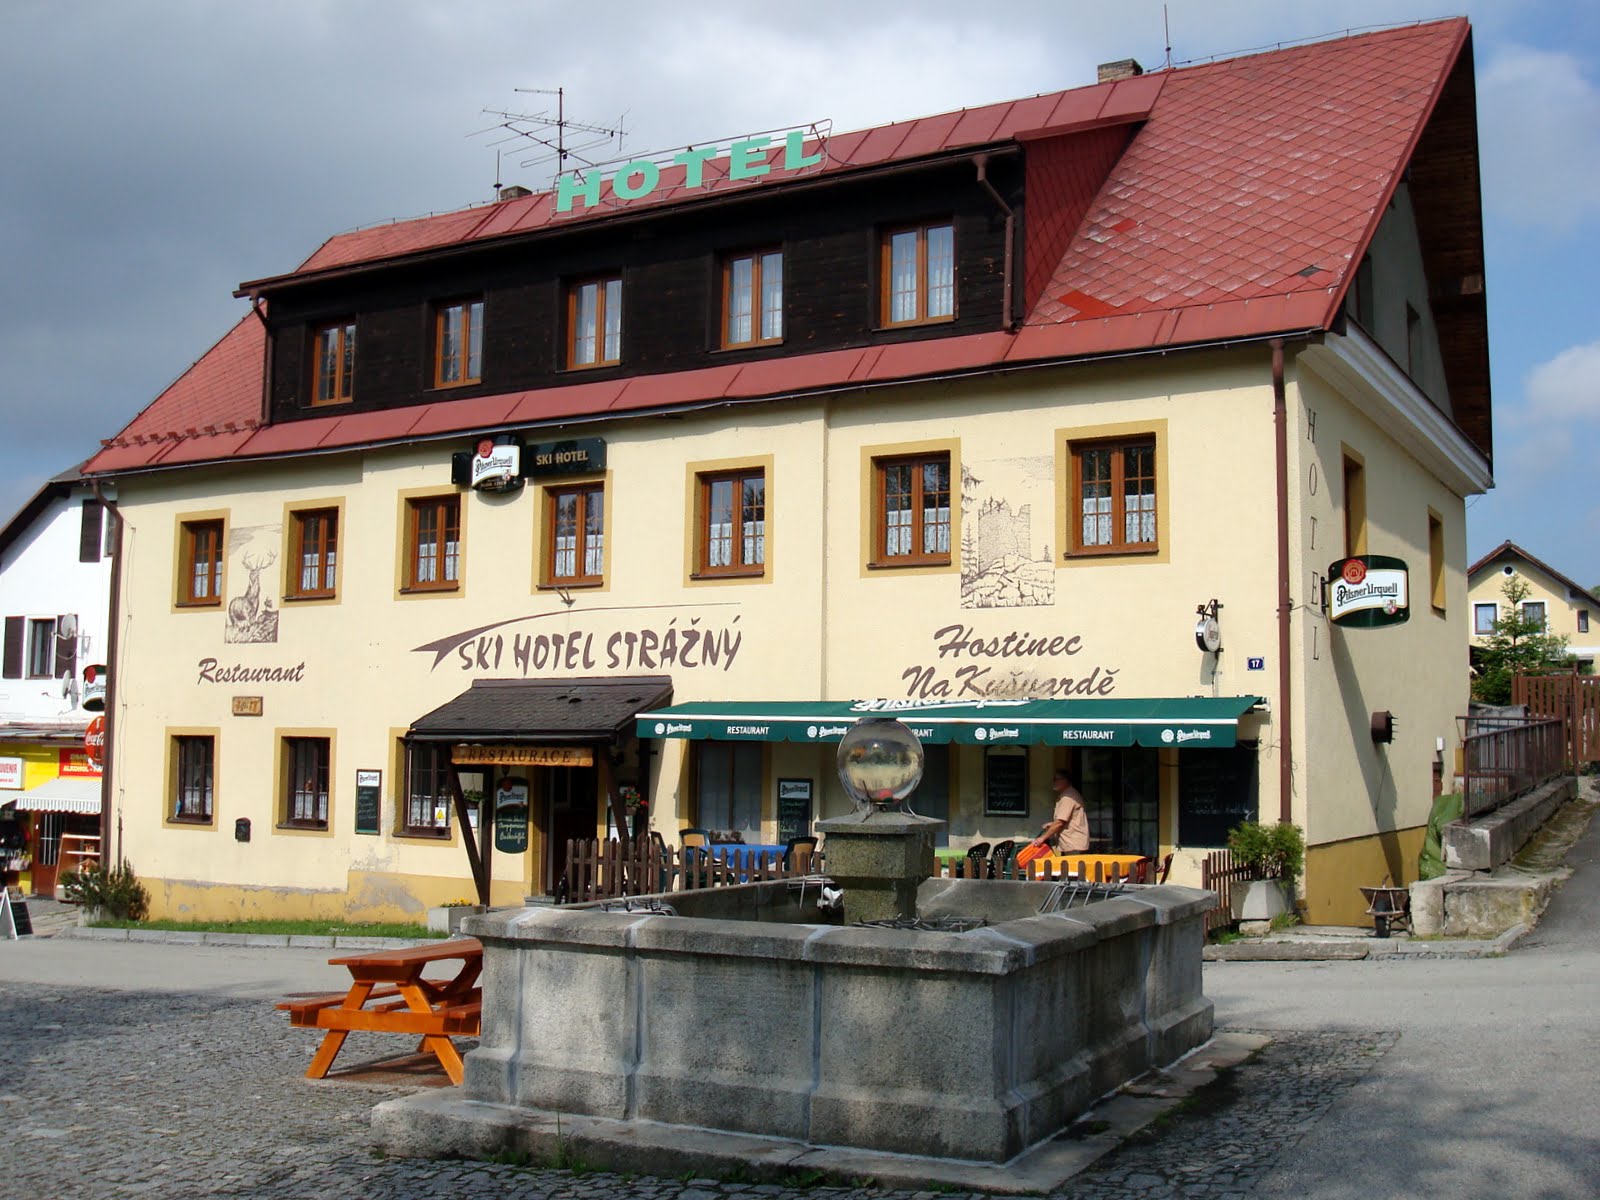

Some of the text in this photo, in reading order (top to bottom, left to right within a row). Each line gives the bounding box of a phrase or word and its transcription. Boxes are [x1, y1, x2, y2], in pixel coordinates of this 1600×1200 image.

[557, 130, 822, 212] HOTEL
[536, 450, 588, 466] SKI HOTEL
[1336, 582, 1398, 607] Pilsner Urquell
[458, 615, 742, 677] SKI HOTEL STRÁŽNÝ
[933, 624, 1083, 659] Hostinec
[197, 657, 305, 686] Restaurant
[1251, 660, 1260, 668] 17
[901, 665, 953, 698] Na
[726, 726, 770, 735] RESTAURANT
[1062, 730, 1115, 740] RESTAURANT
[468, 748, 572, 763] RESTAURACE
